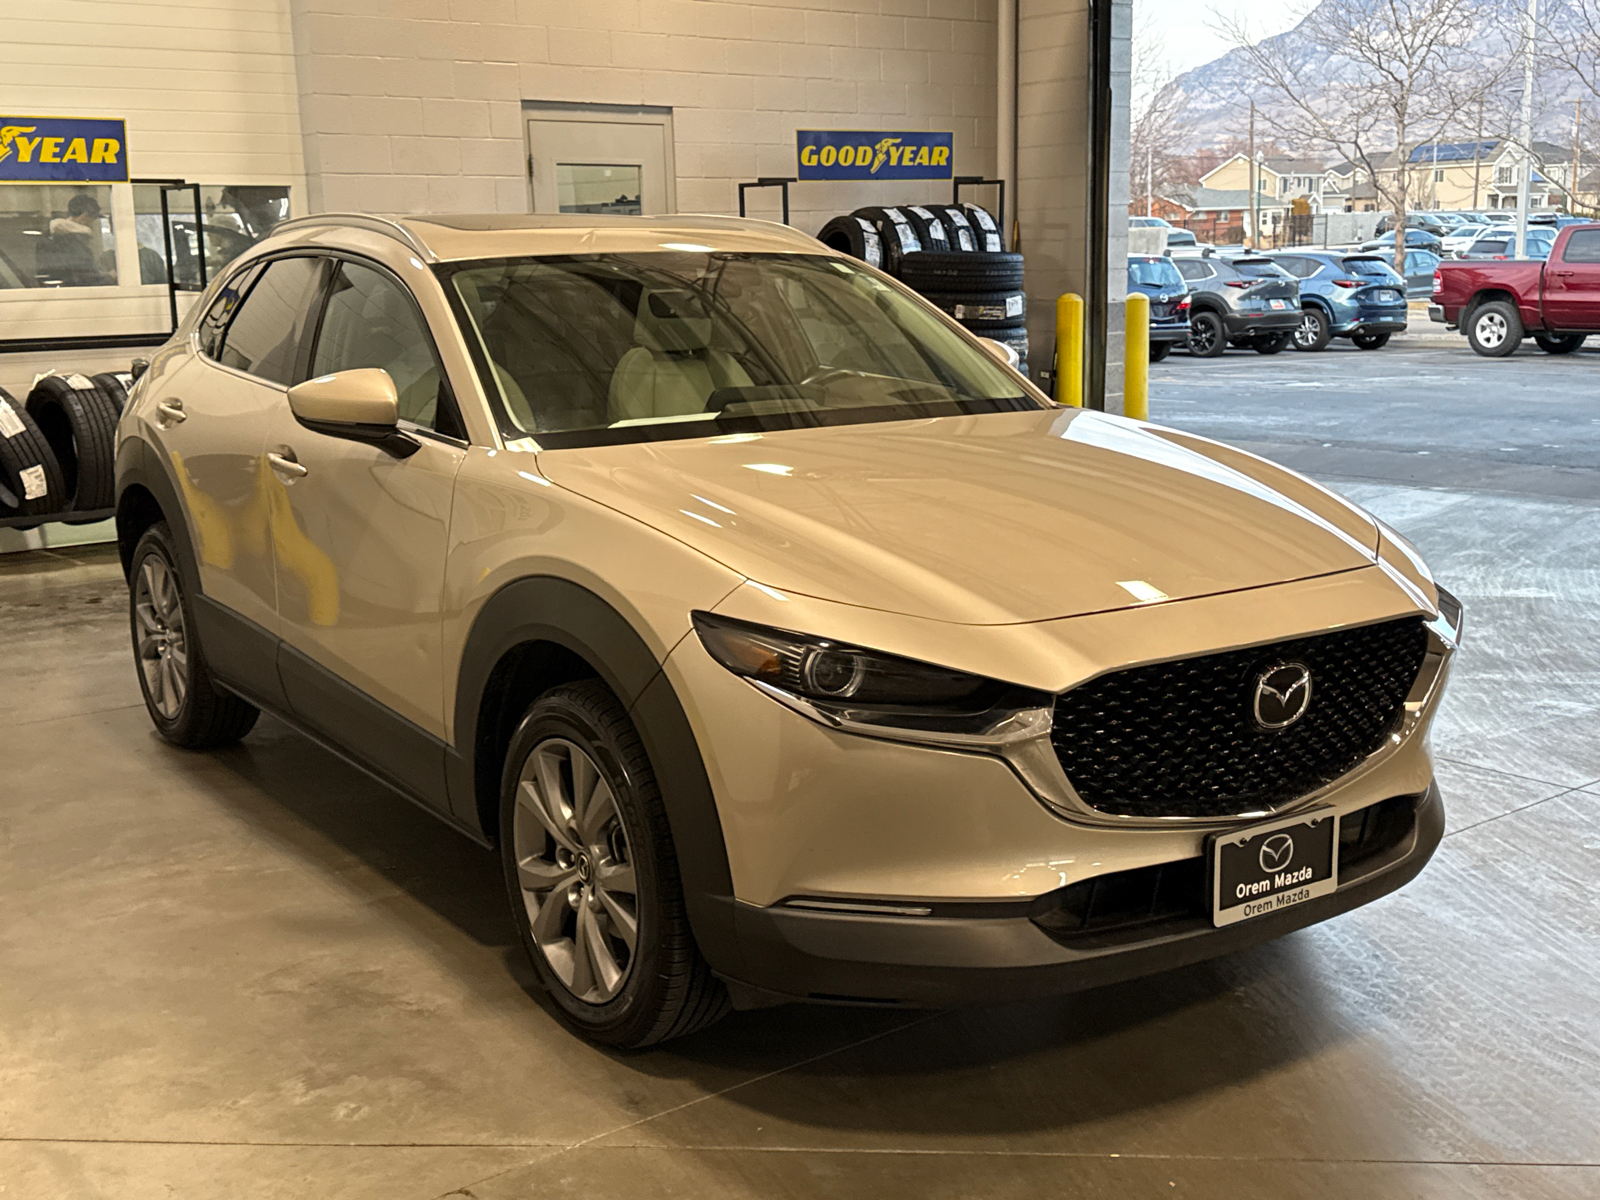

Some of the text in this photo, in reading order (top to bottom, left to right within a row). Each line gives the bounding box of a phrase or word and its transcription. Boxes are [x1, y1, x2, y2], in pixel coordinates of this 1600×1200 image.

[14, 136, 120, 163] YEAR
[1236, 866, 1313, 899] Orem Mazda
[1243, 888, 1310, 917] Orem Mazda
